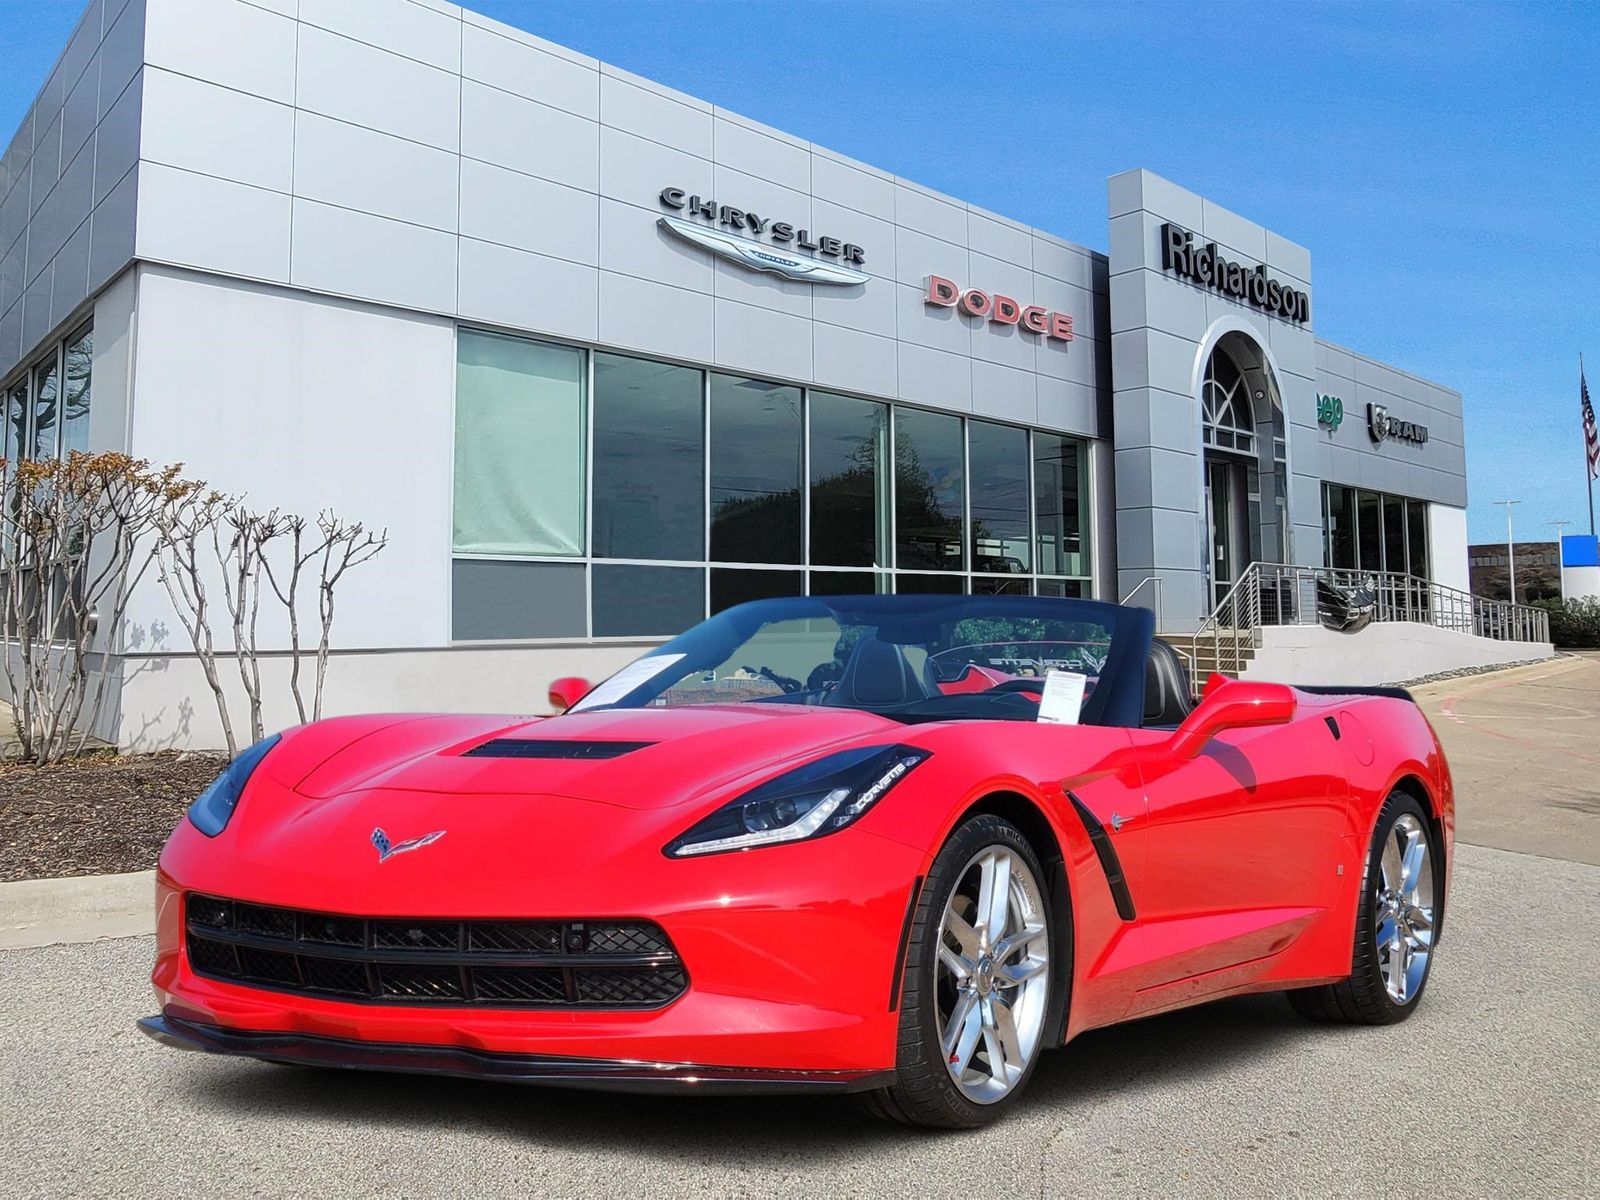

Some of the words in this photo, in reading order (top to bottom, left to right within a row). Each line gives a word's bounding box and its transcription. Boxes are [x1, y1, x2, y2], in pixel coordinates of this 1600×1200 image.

[659, 187, 866, 264] CHRYSLER
[1160, 222, 1310, 323] Richardson
[923, 274, 1074, 342] DODGE
[1385, 416, 1429, 443] RAM
[856, 762, 906, 810] CORVETTE
